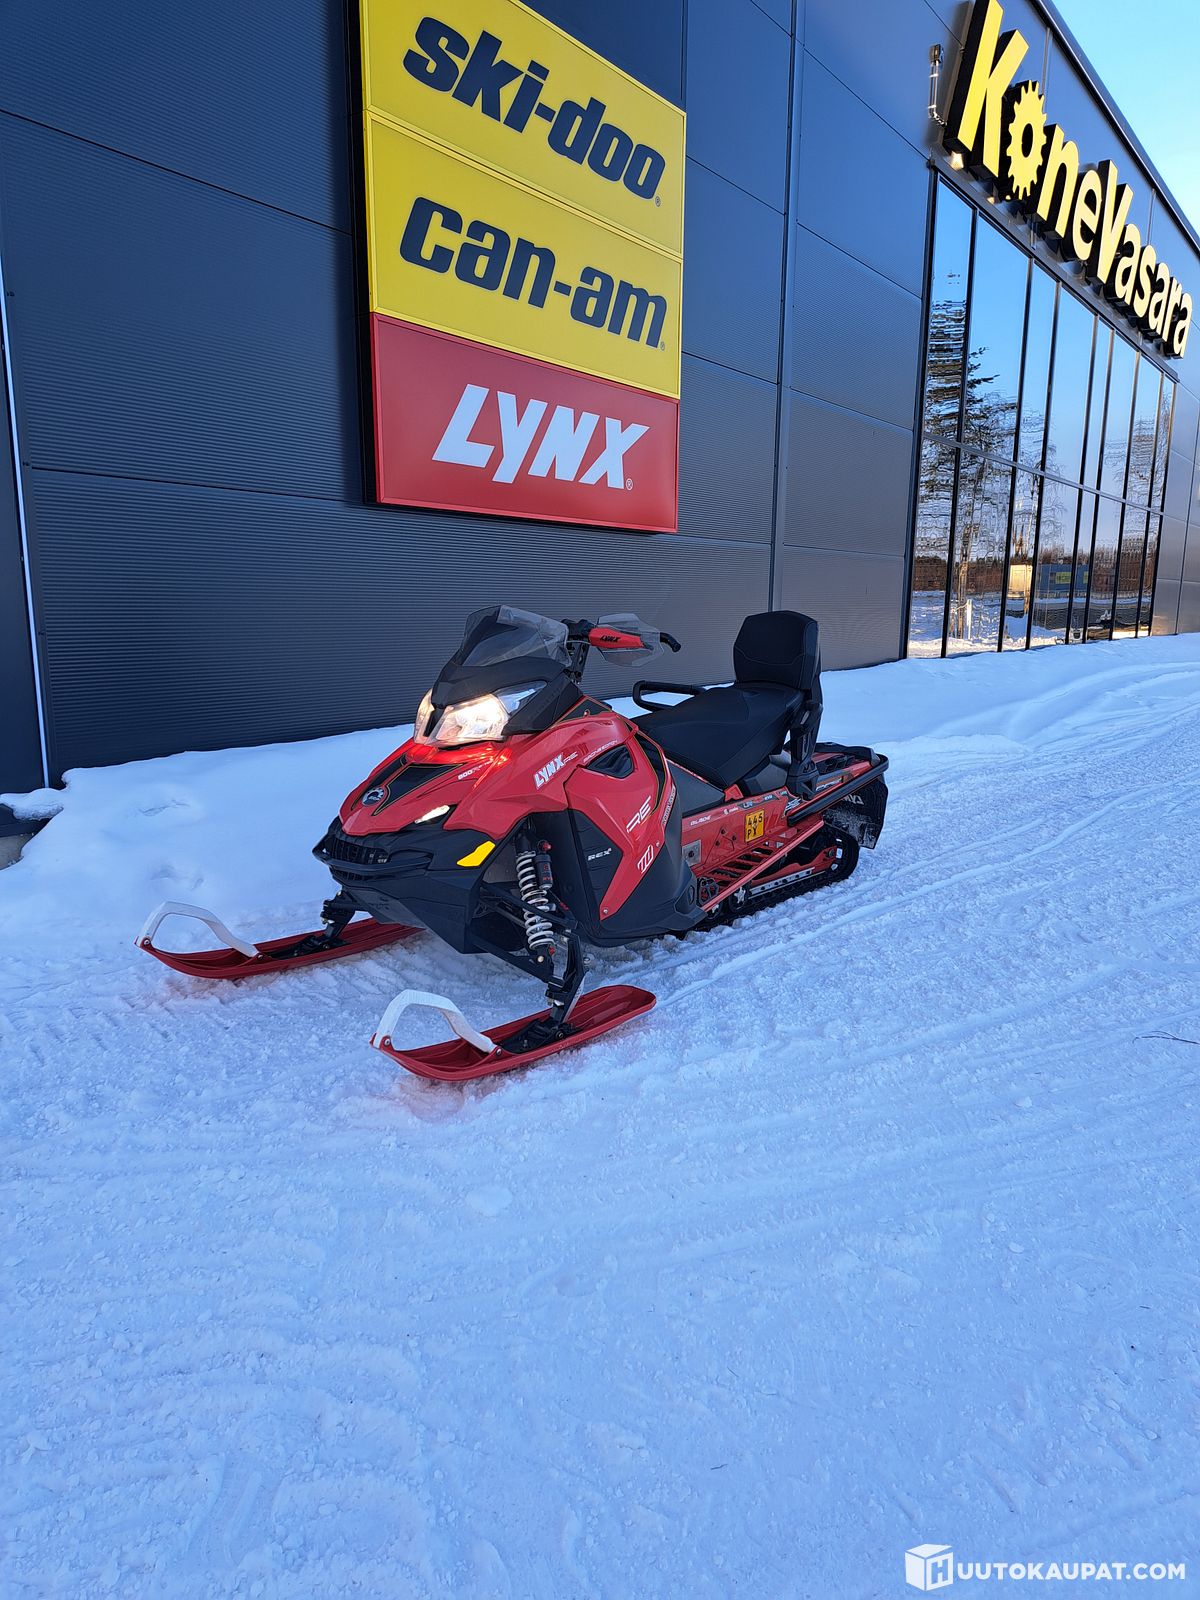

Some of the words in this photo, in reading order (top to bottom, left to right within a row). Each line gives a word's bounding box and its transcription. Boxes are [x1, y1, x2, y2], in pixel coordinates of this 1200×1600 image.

[403, 16, 666, 200] ski-doo
[400, 196, 668, 349] can-am
[432, 384, 650, 490] LYNX
[534, 753, 564, 790] LYNX
[746, 827, 758, 840] PY
[747, 812, 763, 826] 445
